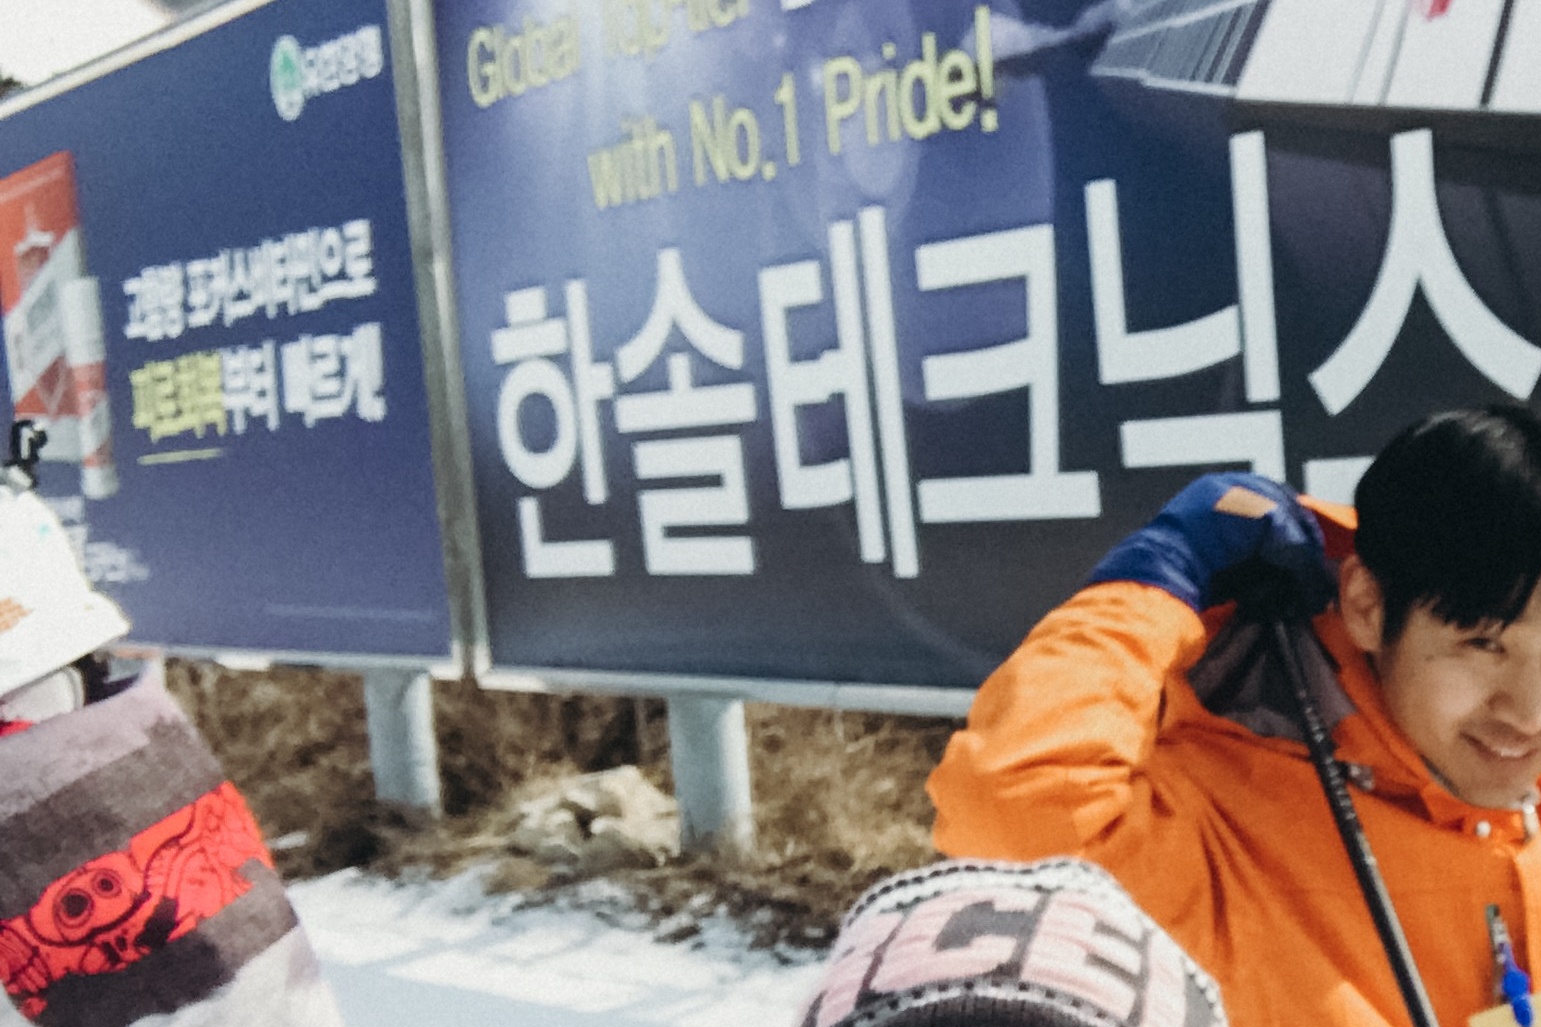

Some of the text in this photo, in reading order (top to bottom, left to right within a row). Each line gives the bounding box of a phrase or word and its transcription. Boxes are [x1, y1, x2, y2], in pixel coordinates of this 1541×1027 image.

[587, 5, 998, 210] with No.1 Pride!
